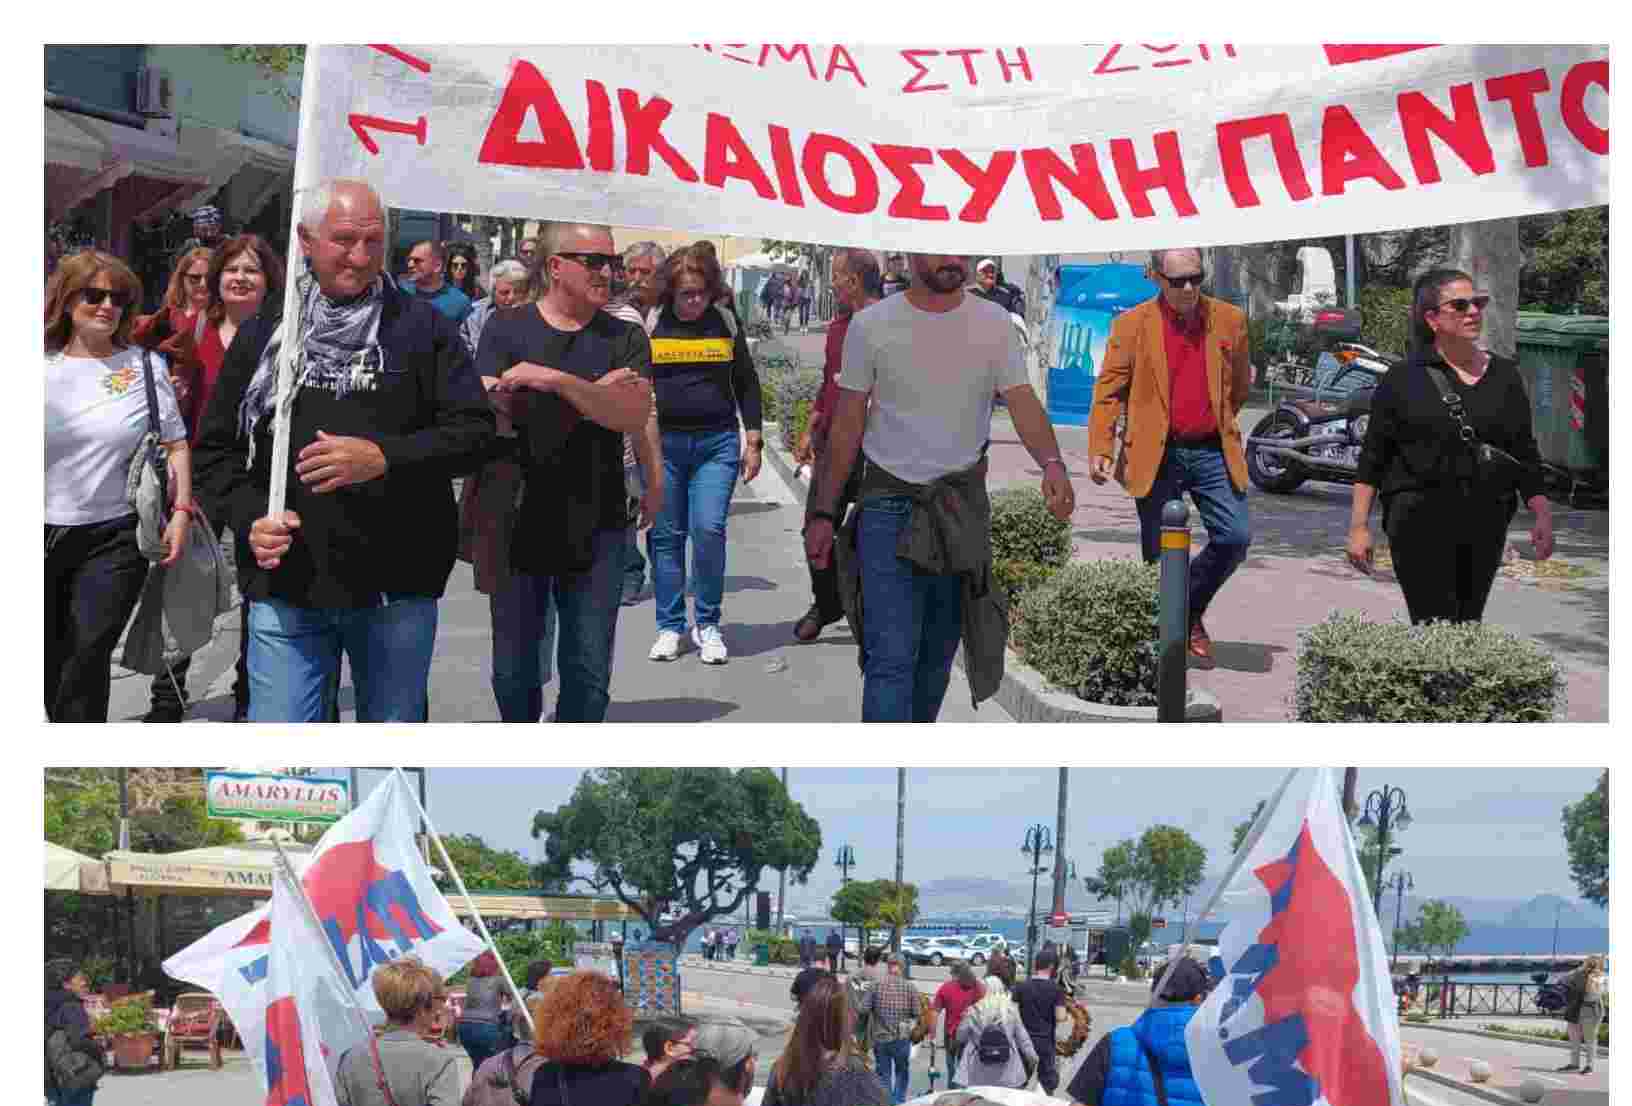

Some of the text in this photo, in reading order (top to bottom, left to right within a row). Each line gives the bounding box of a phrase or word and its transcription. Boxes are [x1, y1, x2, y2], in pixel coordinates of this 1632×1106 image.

[899, 47, 1033, 93] ΣΤΗ
[477, 58, 1608, 223] ΔΙΚΑΙΟΣΥΝΗ ΠΑΝΤΟ
[216, 783, 341, 801] AMARYLLIS
